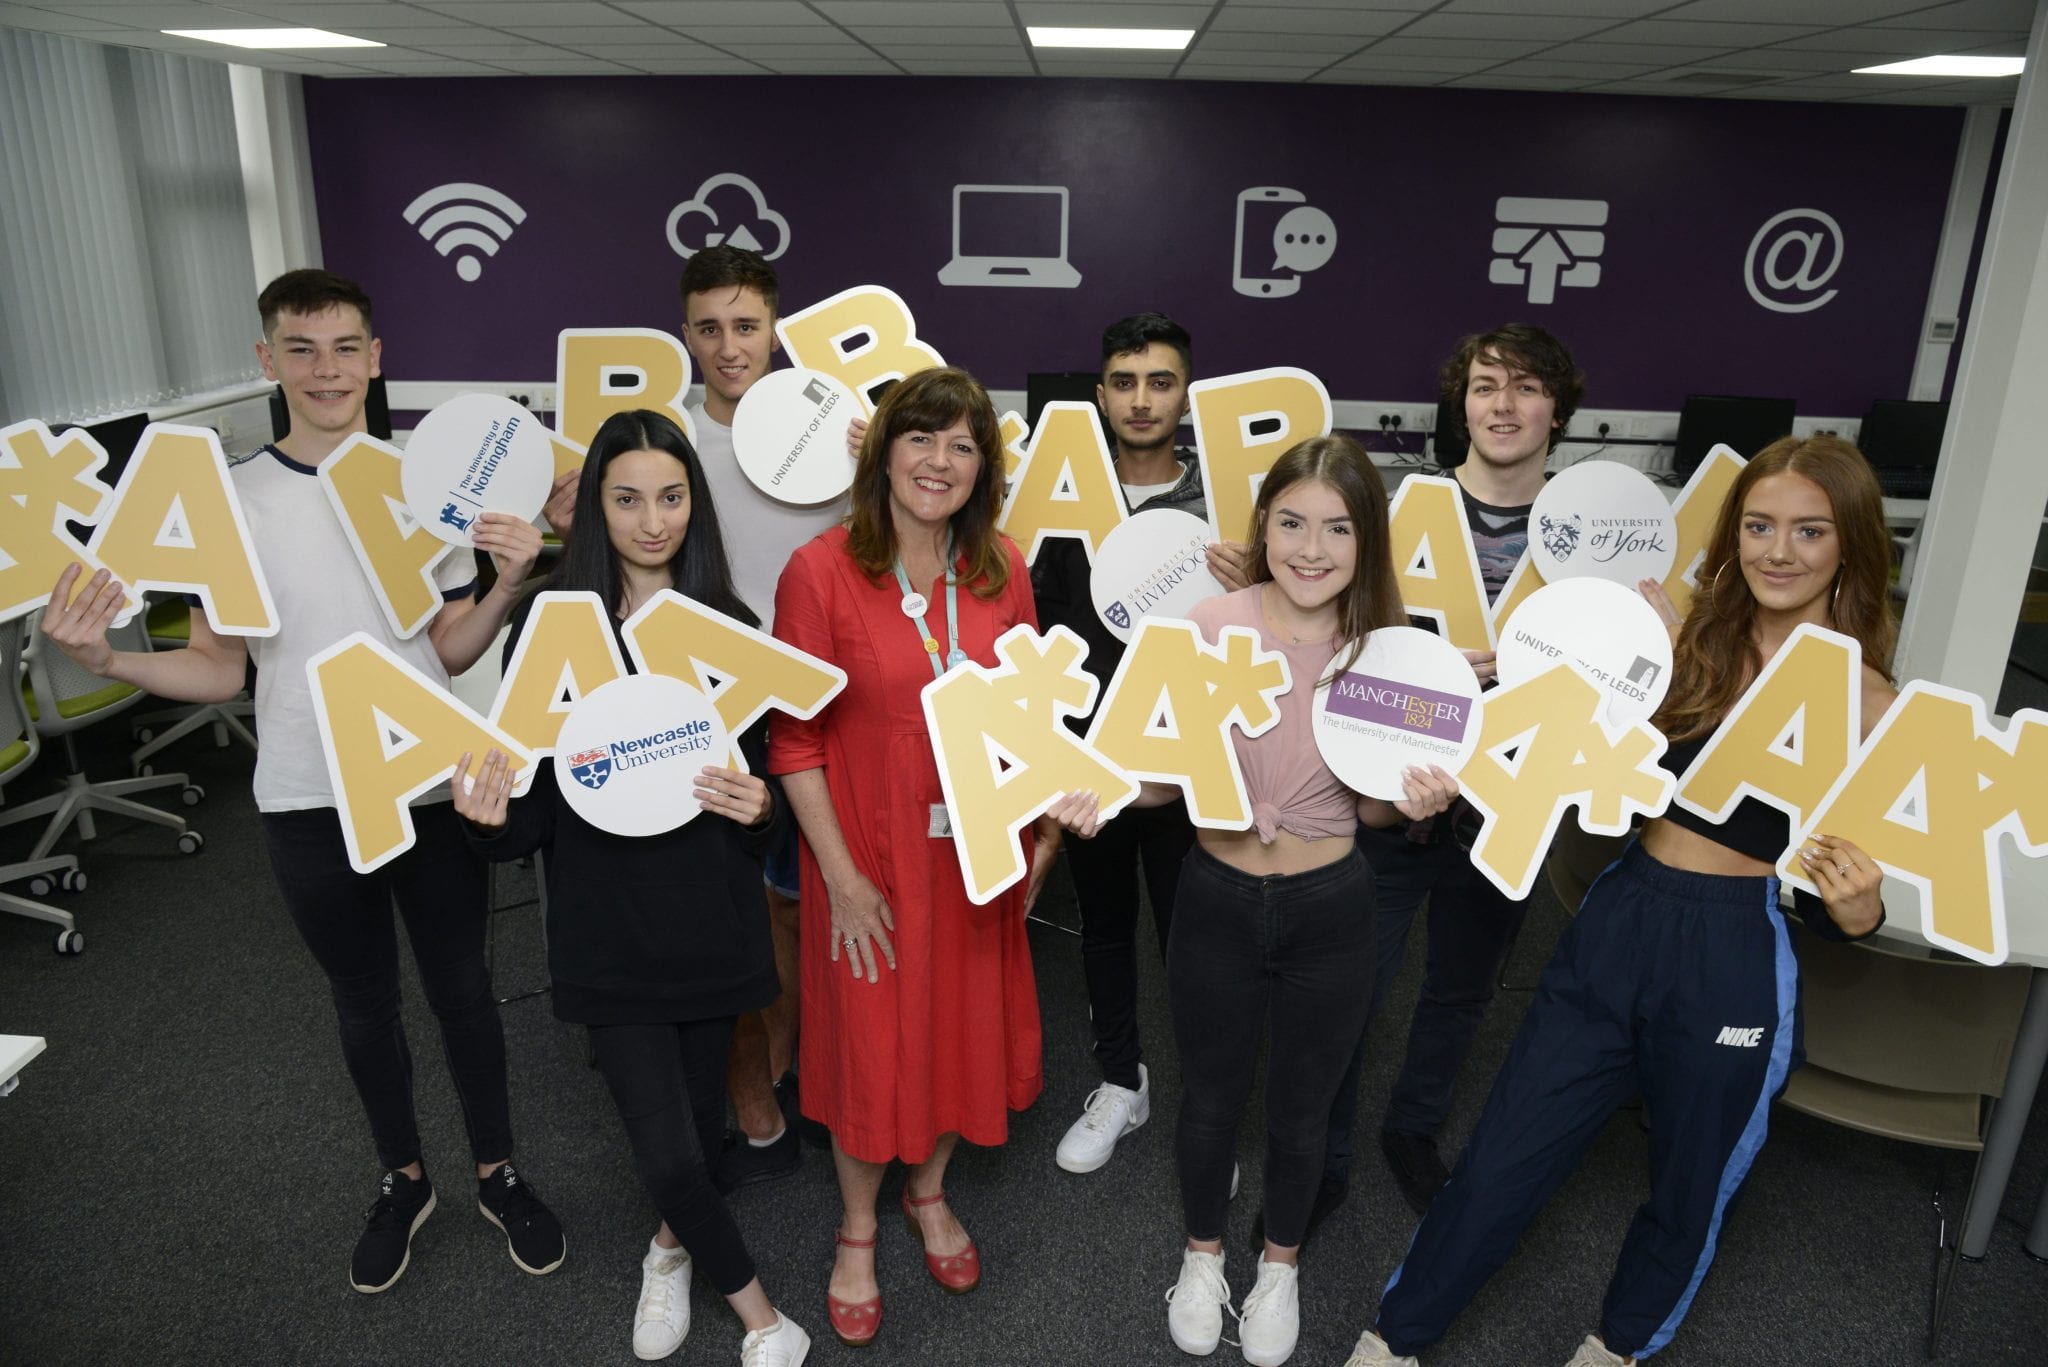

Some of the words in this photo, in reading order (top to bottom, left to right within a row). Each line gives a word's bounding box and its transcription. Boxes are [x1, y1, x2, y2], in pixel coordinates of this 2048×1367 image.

[1744, 207, 1844, 313] @
[780, 289, 944, 420] B
[460, 474, 473, 489] The
[468, 431, 497, 474] University
[492, 420, 501, 431] of
[470, 416, 521, 496] Nottingham
[771, 431, 811, 485] UNIVERSITY
[809, 417, 821, 432] OF
[818, 392, 840, 419] LEEDS
[999, 405, 1126, 564] A
[92, 427, 275, 632] A
[1590, 529, 1613, 550] of
[1591, 519, 1663, 527] UNIVERSITY
[1591, 529, 1667, 562] York
[1127, 549, 1186, 600] UNIVERSITY
[1389, 478, 1494, 650] A
[494, 596, 625, 792] A
[627, 594, 842, 773] A
[1336, 680, 1462, 722] MANCHESTER
[1609, 677, 1648, 702] LEEDS
[312, 637, 533, 869] A
[610, 719, 711, 757] Newcastle
[613, 734, 713, 772] University
[1322, 715, 1340, 728] The
[1341, 719, 1389, 742] University
[1389, 732, 1401, 743] of
[1401, 734, 1461, 757] Manchester
[1403, 711, 1433, 729] 1824
[1677, 628, 1855, 829] A
[1715, 1026, 1765, 1047] NIKE
